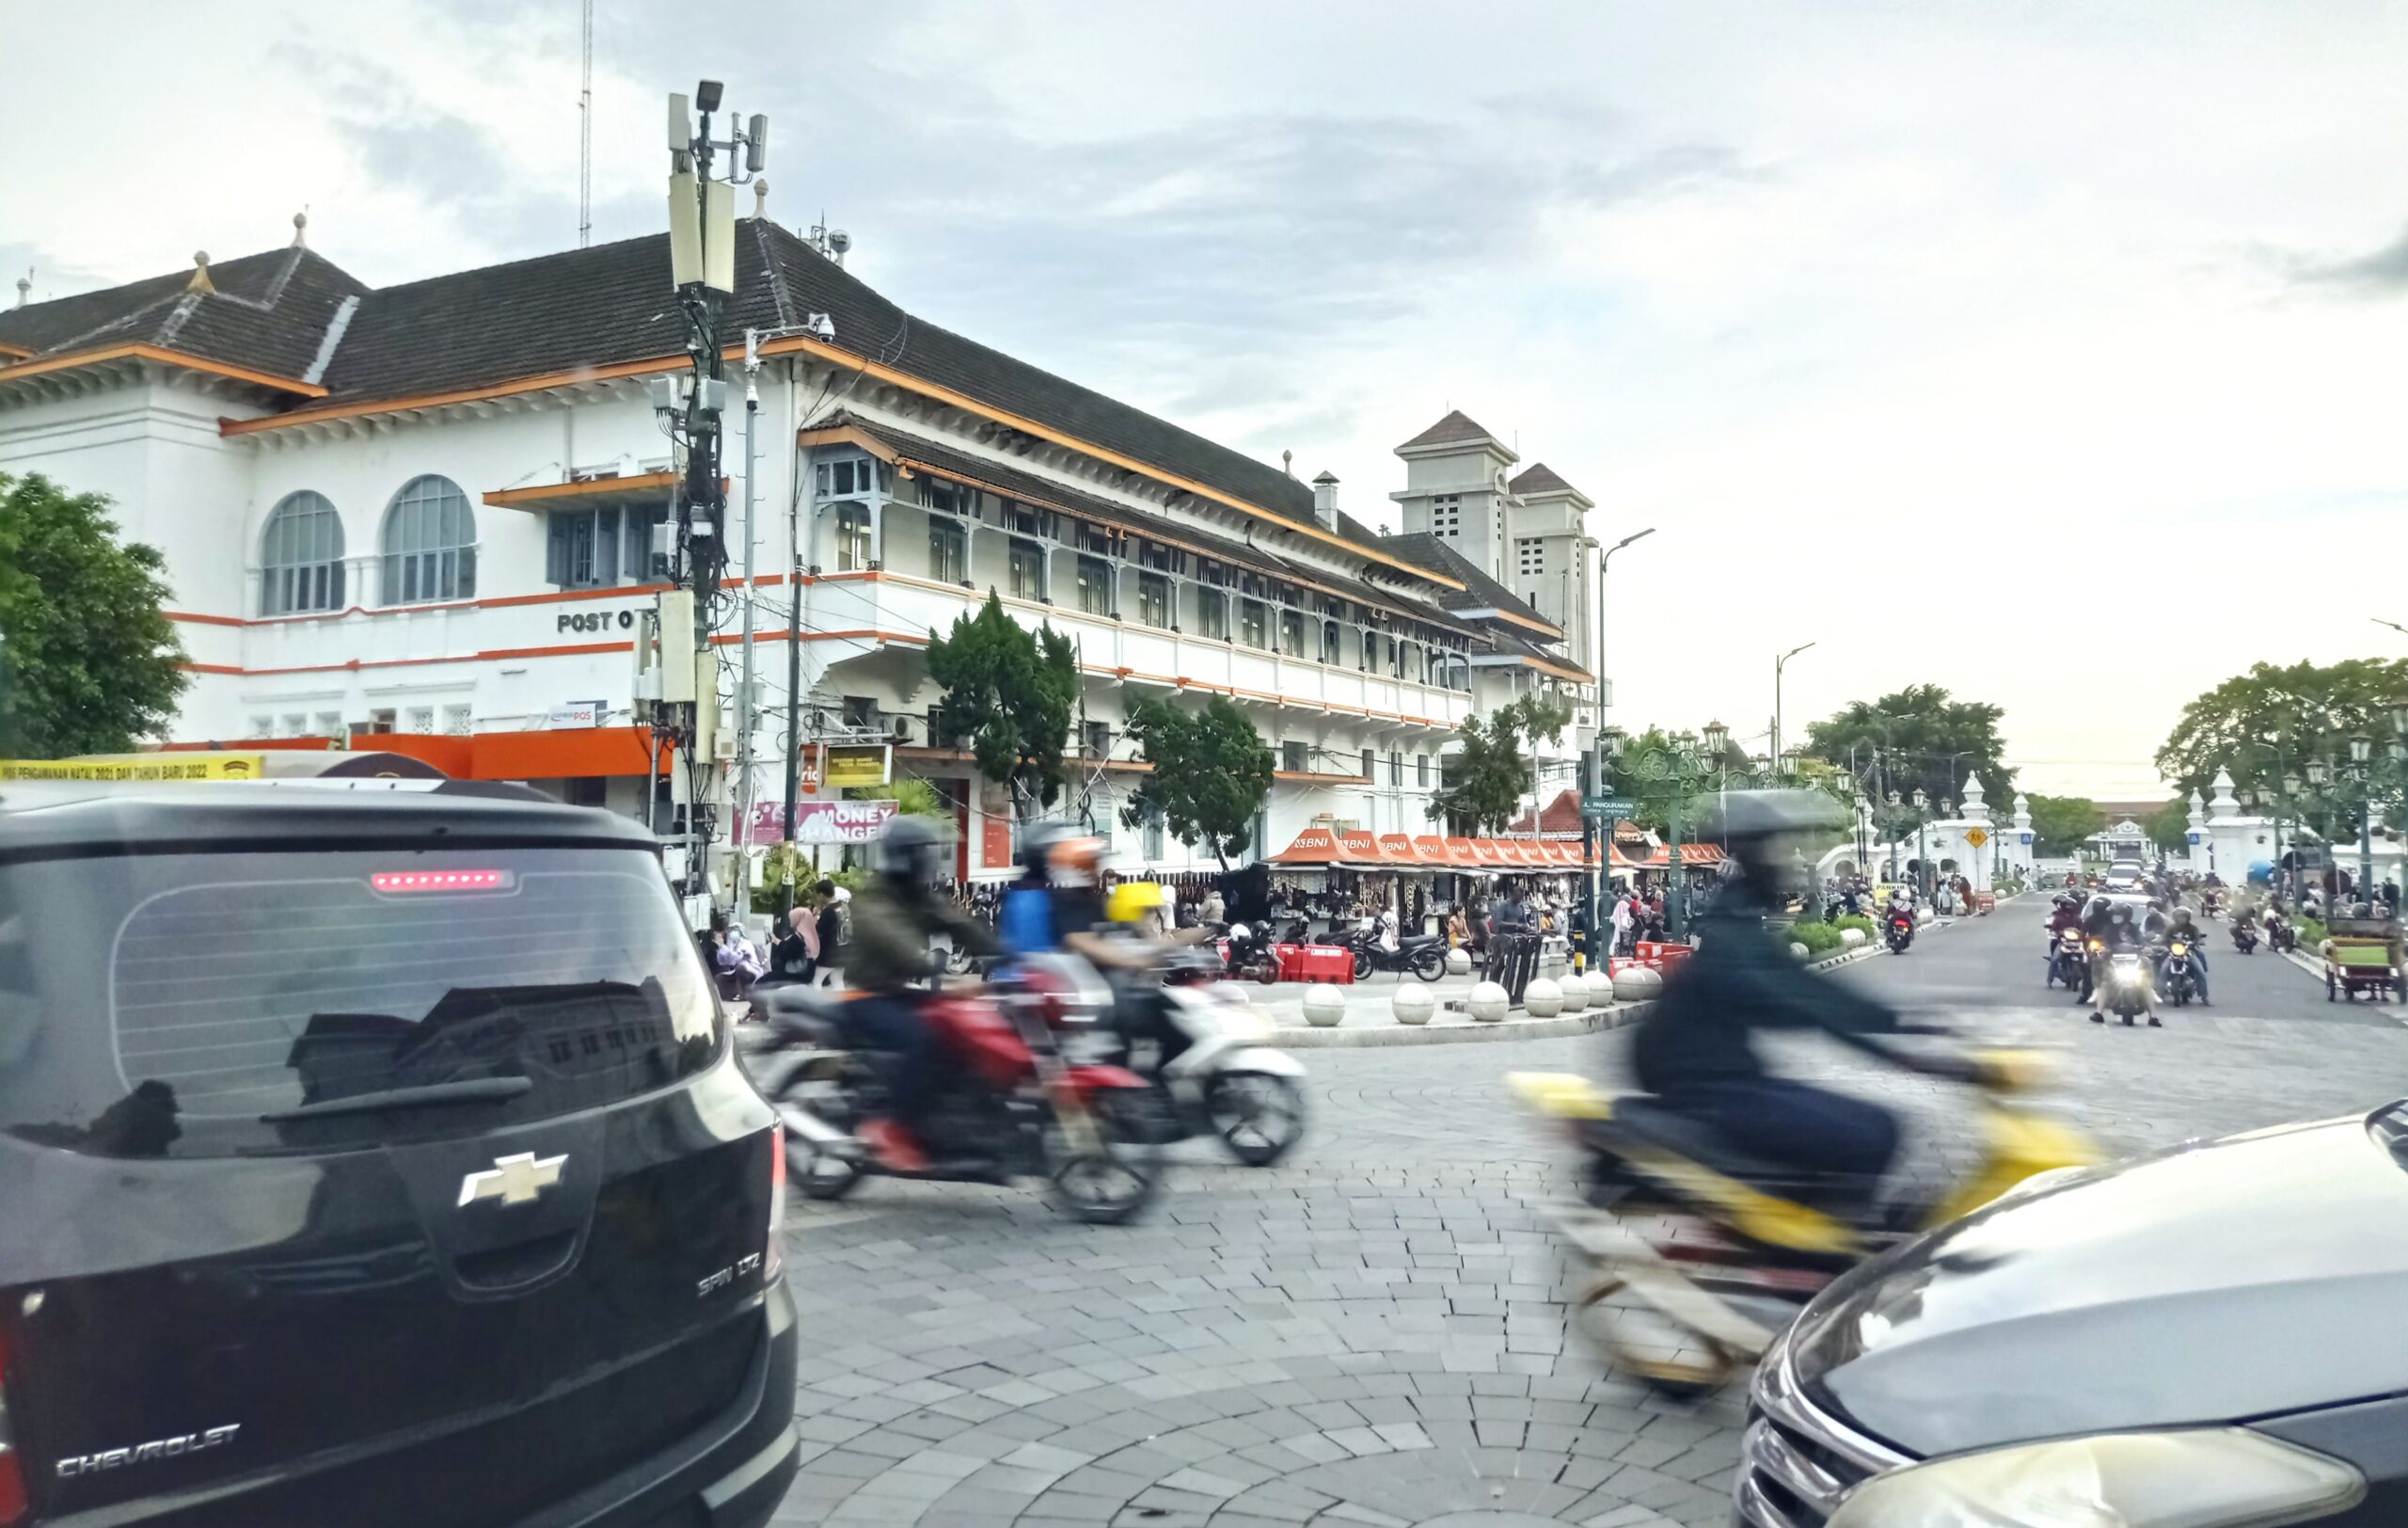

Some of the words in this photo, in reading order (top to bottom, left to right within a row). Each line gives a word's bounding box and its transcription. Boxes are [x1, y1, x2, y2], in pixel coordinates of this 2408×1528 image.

[557, 612, 612, 633] POST
[573, 711, 591, 720] POS
[71, 767, 93, 779] NATAL
[95, 767, 113, 780] 2021
[115, 767, 132, 779] DAN
[134, 766, 160, 779] TAHUN
[162, 765, 184, 779] BARU
[186, 764, 207, 778] 2022
[818, 808, 893, 823] MONEY
[1306, 838, 1328, 848] BNI
[1349, 839, 1370, 849] BNI
[1386, 842, 1406, 851] BNI
[699, 1266, 733, 1297] SPIN
[737, 1252, 760, 1276] LTZ
[56, 1424, 241, 1477] CHEVROLET
